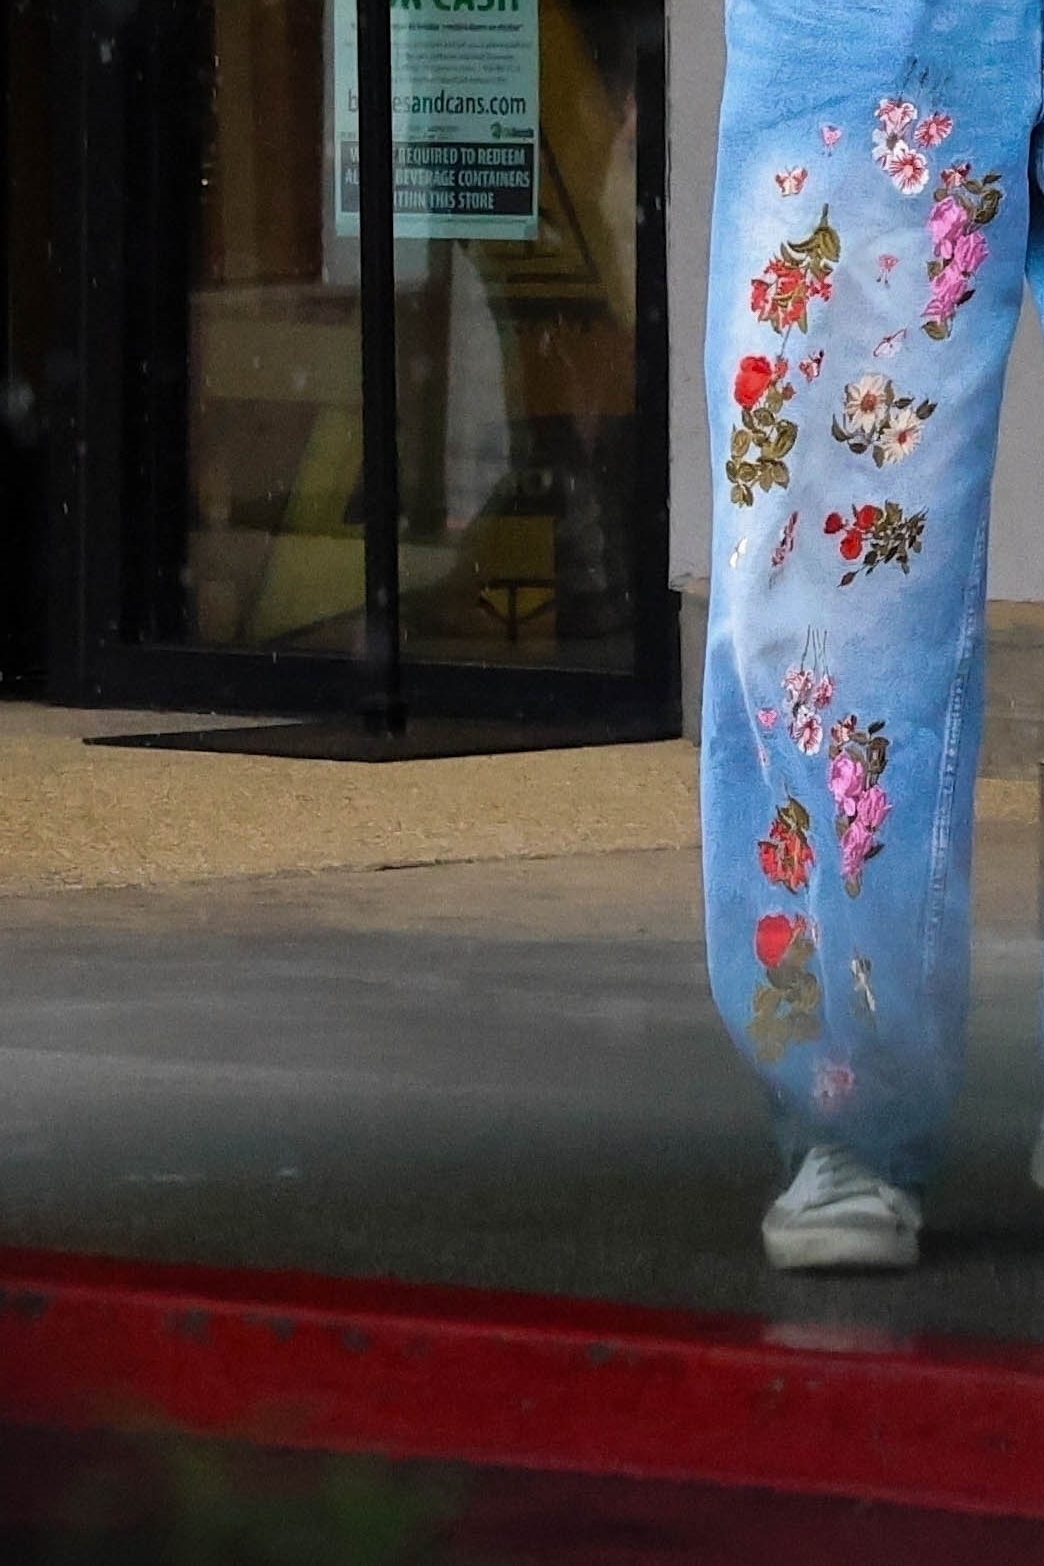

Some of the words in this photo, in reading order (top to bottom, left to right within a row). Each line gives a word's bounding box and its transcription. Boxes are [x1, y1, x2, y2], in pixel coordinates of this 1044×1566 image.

[398, 147, 457, 165] REQUIRED
[460, 147, 475, 165] TO
[478, 148, 526, 166] REDEEM
[395, 169, 456, 187] BEVERAGE
[458, 170, 530, 188] CONTAINERS
[429, 191, 456, 209] THIS
[458, 192, 494, 209] STORE
